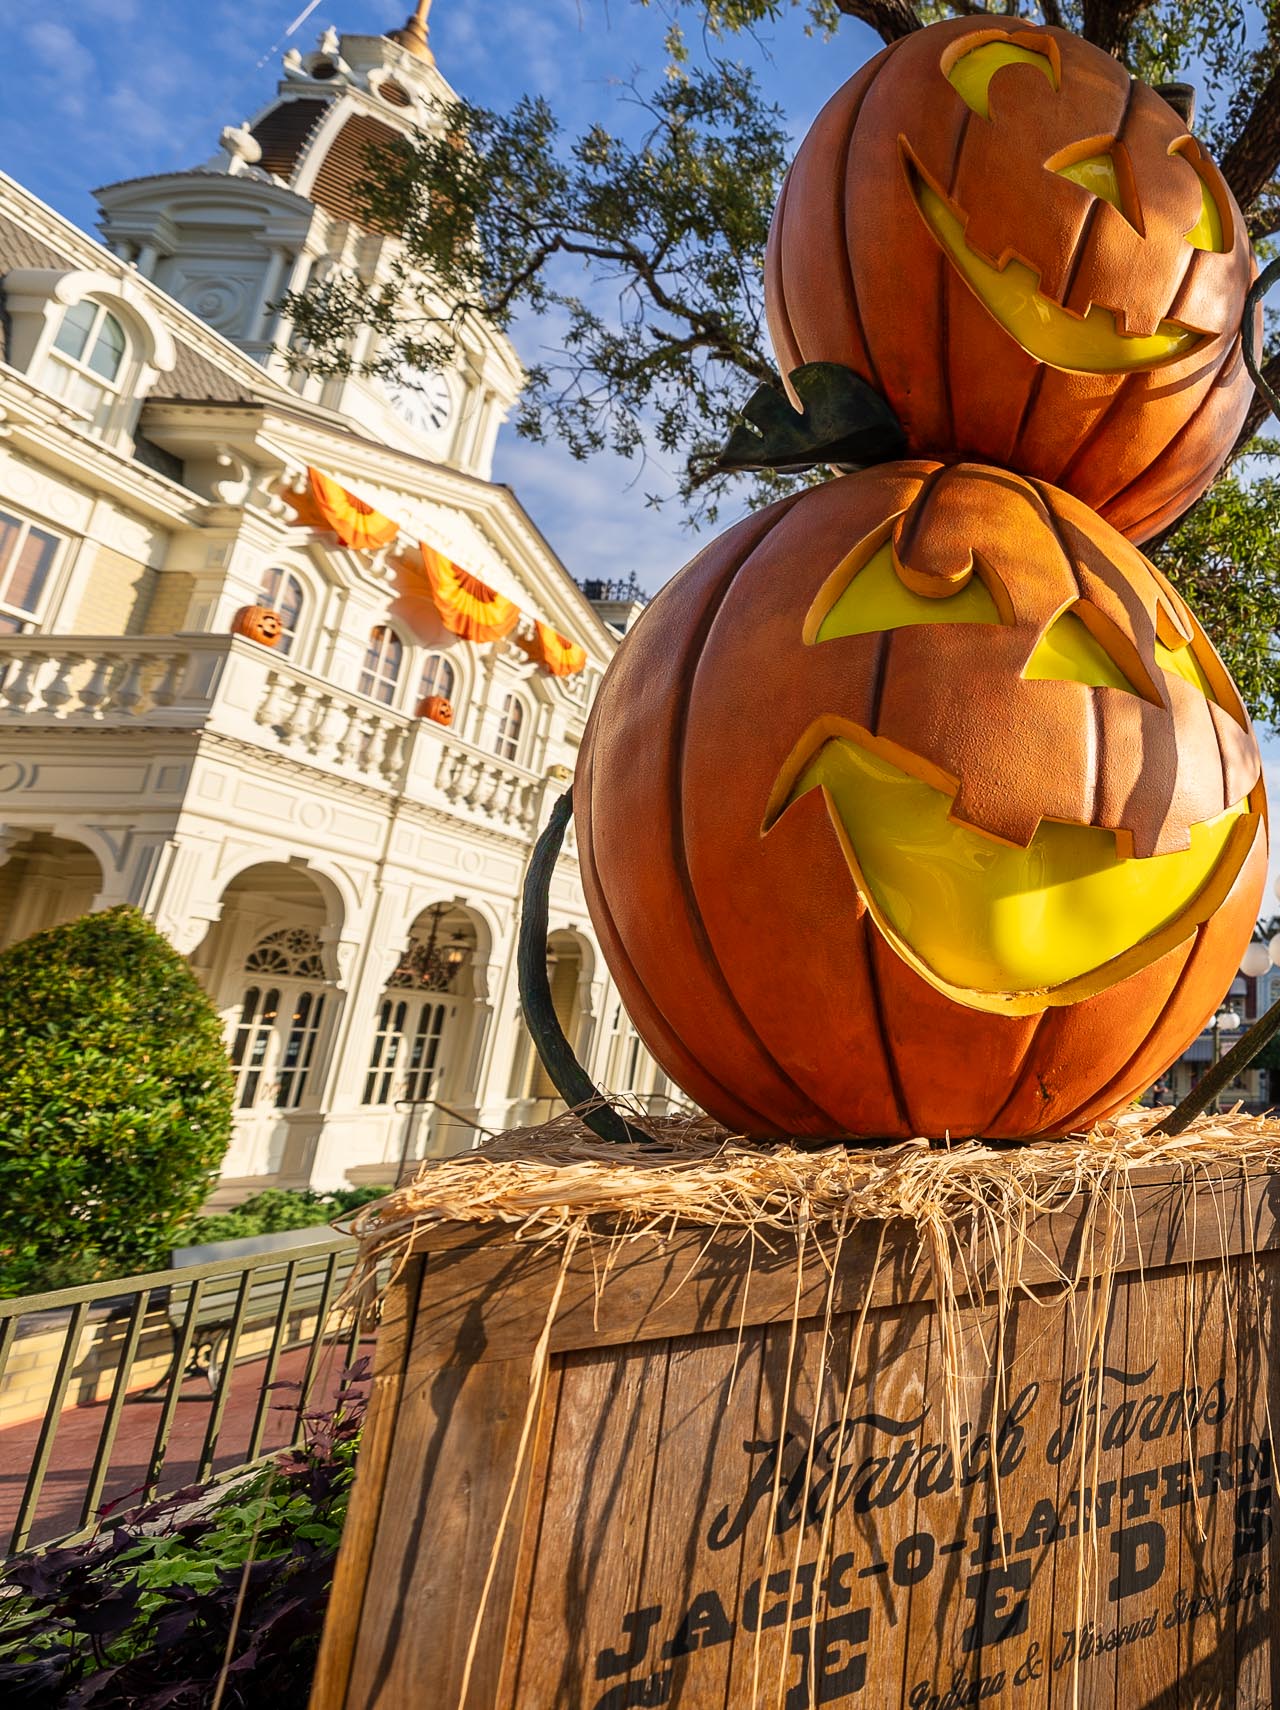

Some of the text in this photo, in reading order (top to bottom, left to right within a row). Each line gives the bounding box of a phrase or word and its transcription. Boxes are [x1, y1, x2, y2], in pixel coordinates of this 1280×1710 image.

[707, 1360, 1234, 1551] Hartrich Farms
[594, 1438, 1272, 1681] JACK-O-LANTERN
[908, 1667, 1006, 1710] Indiana
[1013, 1641, 1043, 1686] &
[1053, 1605, 1159, 1672] Missouri
[1163, 1586, 1217, 1630] Since
